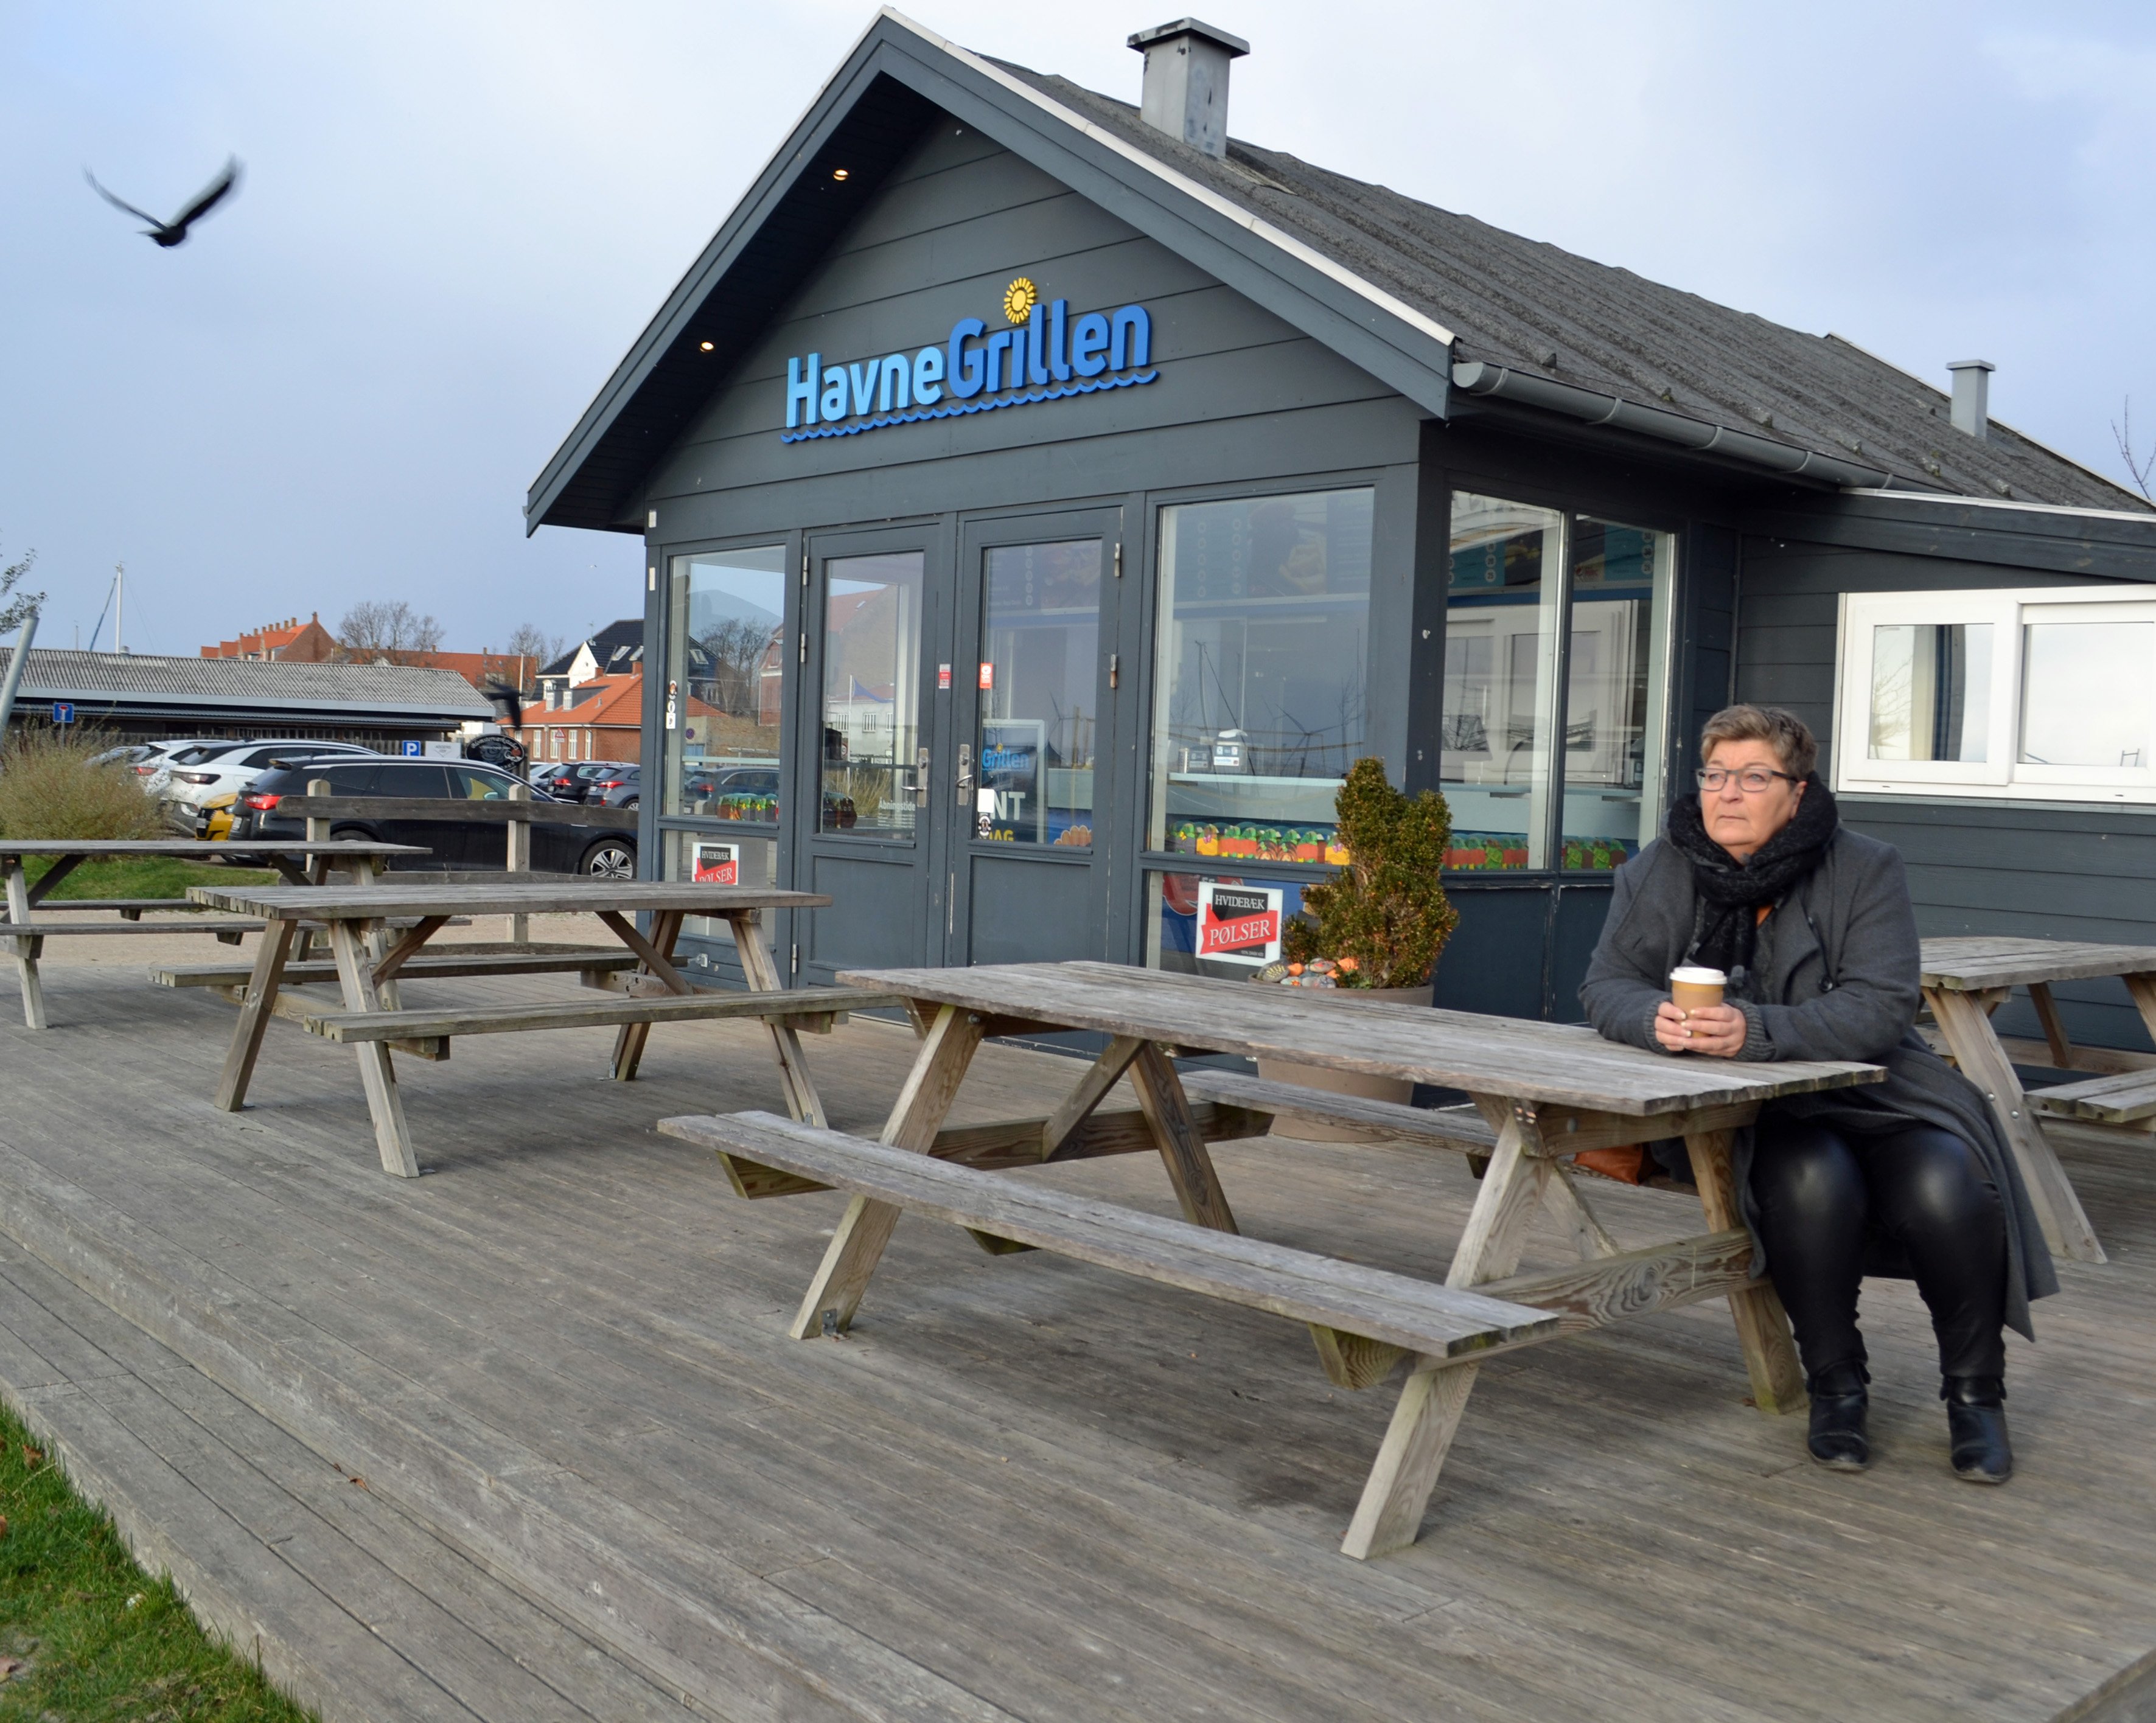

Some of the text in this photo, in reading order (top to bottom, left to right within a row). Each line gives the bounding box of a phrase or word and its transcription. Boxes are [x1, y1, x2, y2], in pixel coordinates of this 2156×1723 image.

[786, 279, 1152, 428] HavneGrillen
[406, 742, 417, 756] P
[878, 796, 915, 812] Åbningstide
[989, 791, 1025, 820] NT
[1215, 894, 1265, 910] HVIDEBÆK
[1209, 919, 1271, 946] PØLSER
